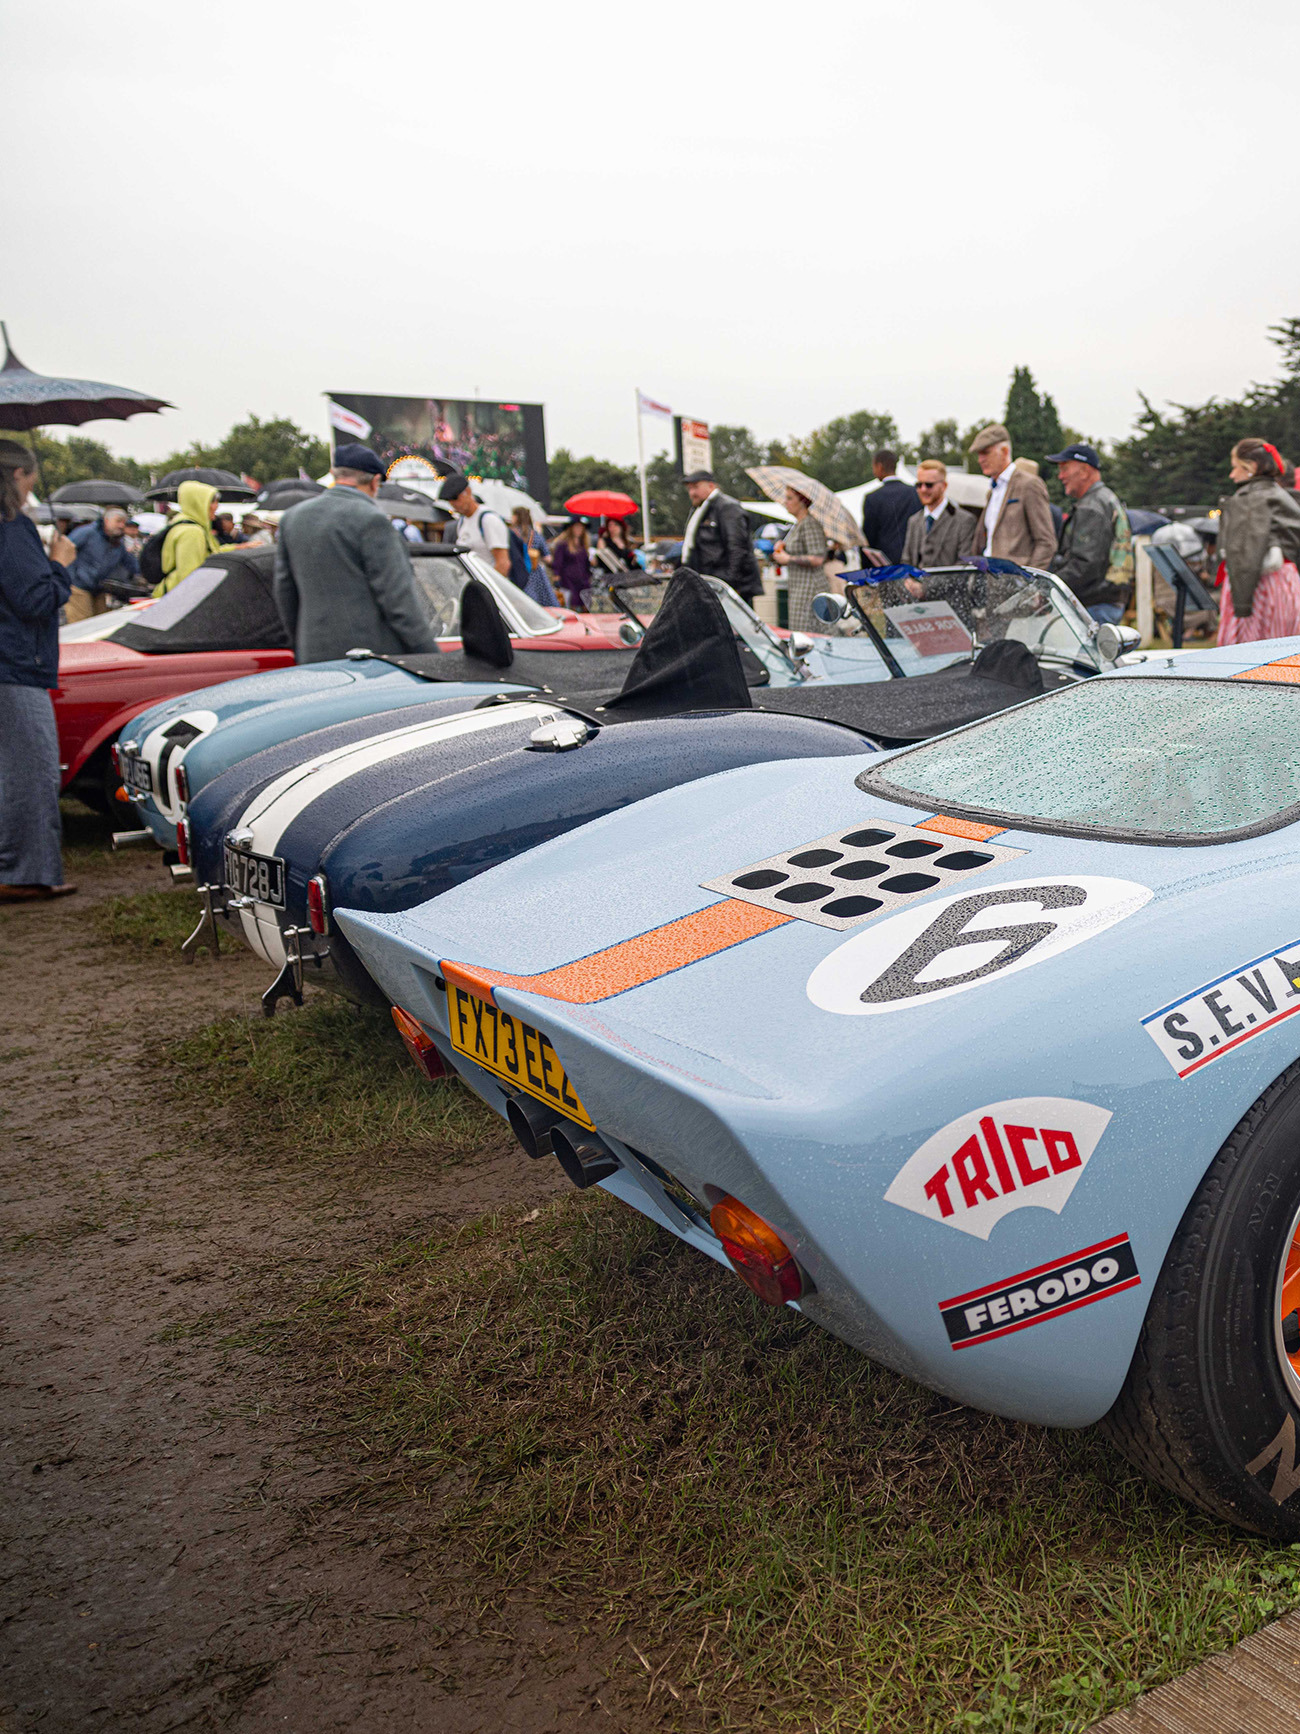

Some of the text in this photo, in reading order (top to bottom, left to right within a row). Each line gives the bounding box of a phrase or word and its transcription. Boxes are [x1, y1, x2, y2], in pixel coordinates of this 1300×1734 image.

[859, 884, 1088, 1004] 6
[456, 987, 519, 1075] FX73
[1162, 969, 1279, 1061] S.E.V
[923, 1115, 1082, 1218] TRICO
[1247, 1172, 1281, 1234] AVON
[963, 1257, 1120, 1333] FERODO
